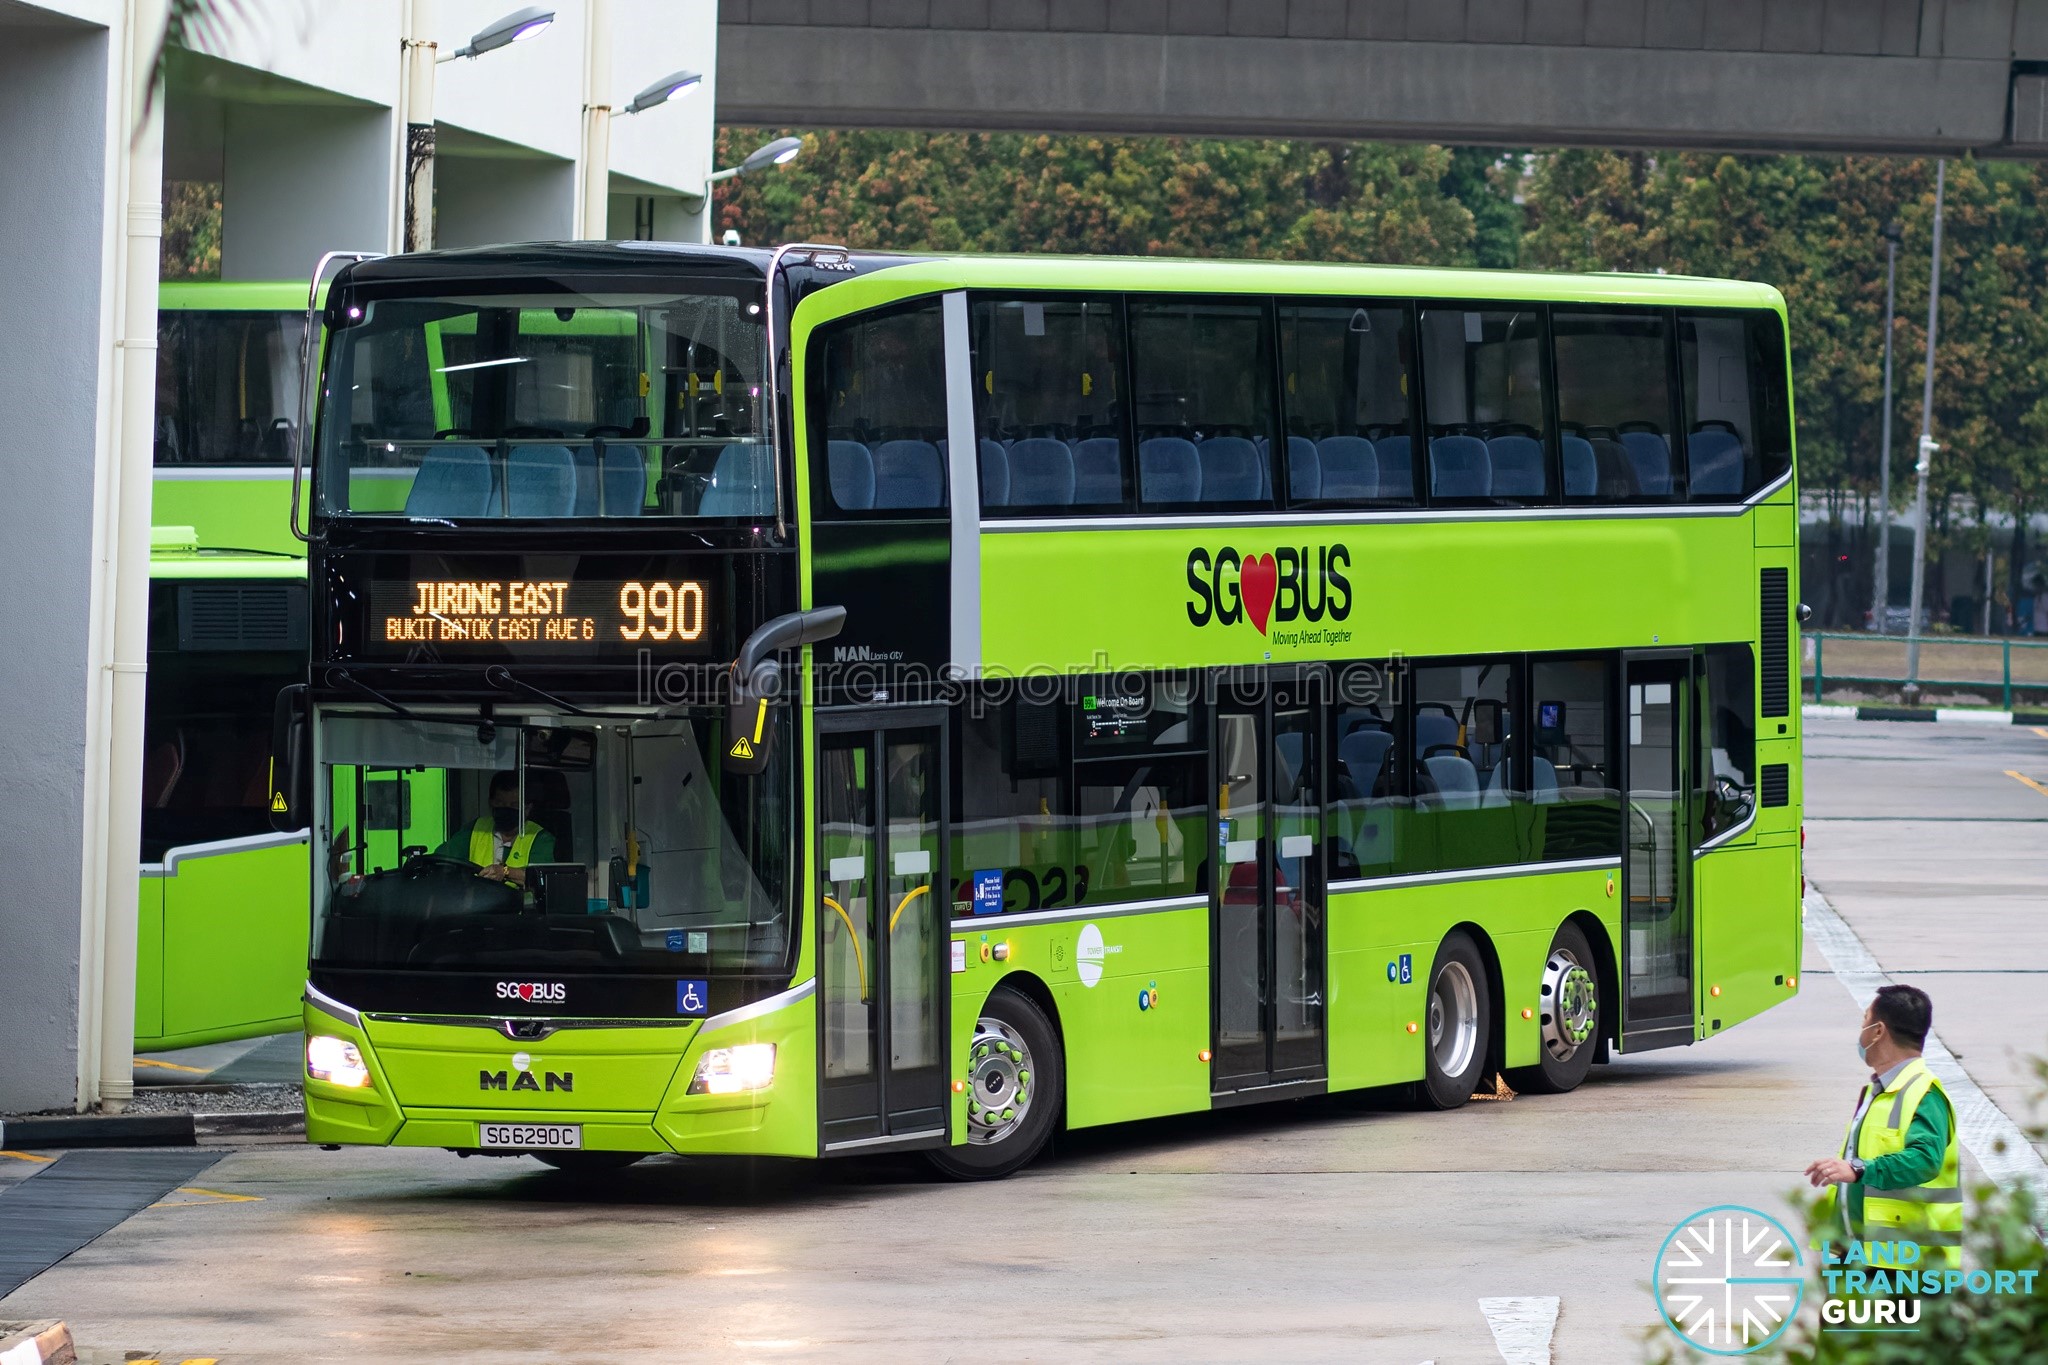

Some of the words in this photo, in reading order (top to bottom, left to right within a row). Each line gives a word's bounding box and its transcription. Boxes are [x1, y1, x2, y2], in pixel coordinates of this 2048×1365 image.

[413, 582, 501, 614] JURONG
[508, 582, 568, 614] EAST
[619, 581, 703, 640] 990
[386, 617, 436, 641] BUKIT
[441, 617, 494, 641] BATOK
[498, 617, 541, 641] EAST
[545, 617, 577, 641] AVE
[582, 617, 595, 641] 6
[1272, 631, 1298, 648] Moving
[1299, 630, 1321, 644] Ahead
[1322, 628, 1352, 646] Together
[834, 645, 870, 662] MAN
[1096, 698, 1119, 707] Welcome
[1128, 696, 1144, 705] Board
[480, 1070, 573, 1092] MAN
[487, 1127, 574, 1146] SG6290C
